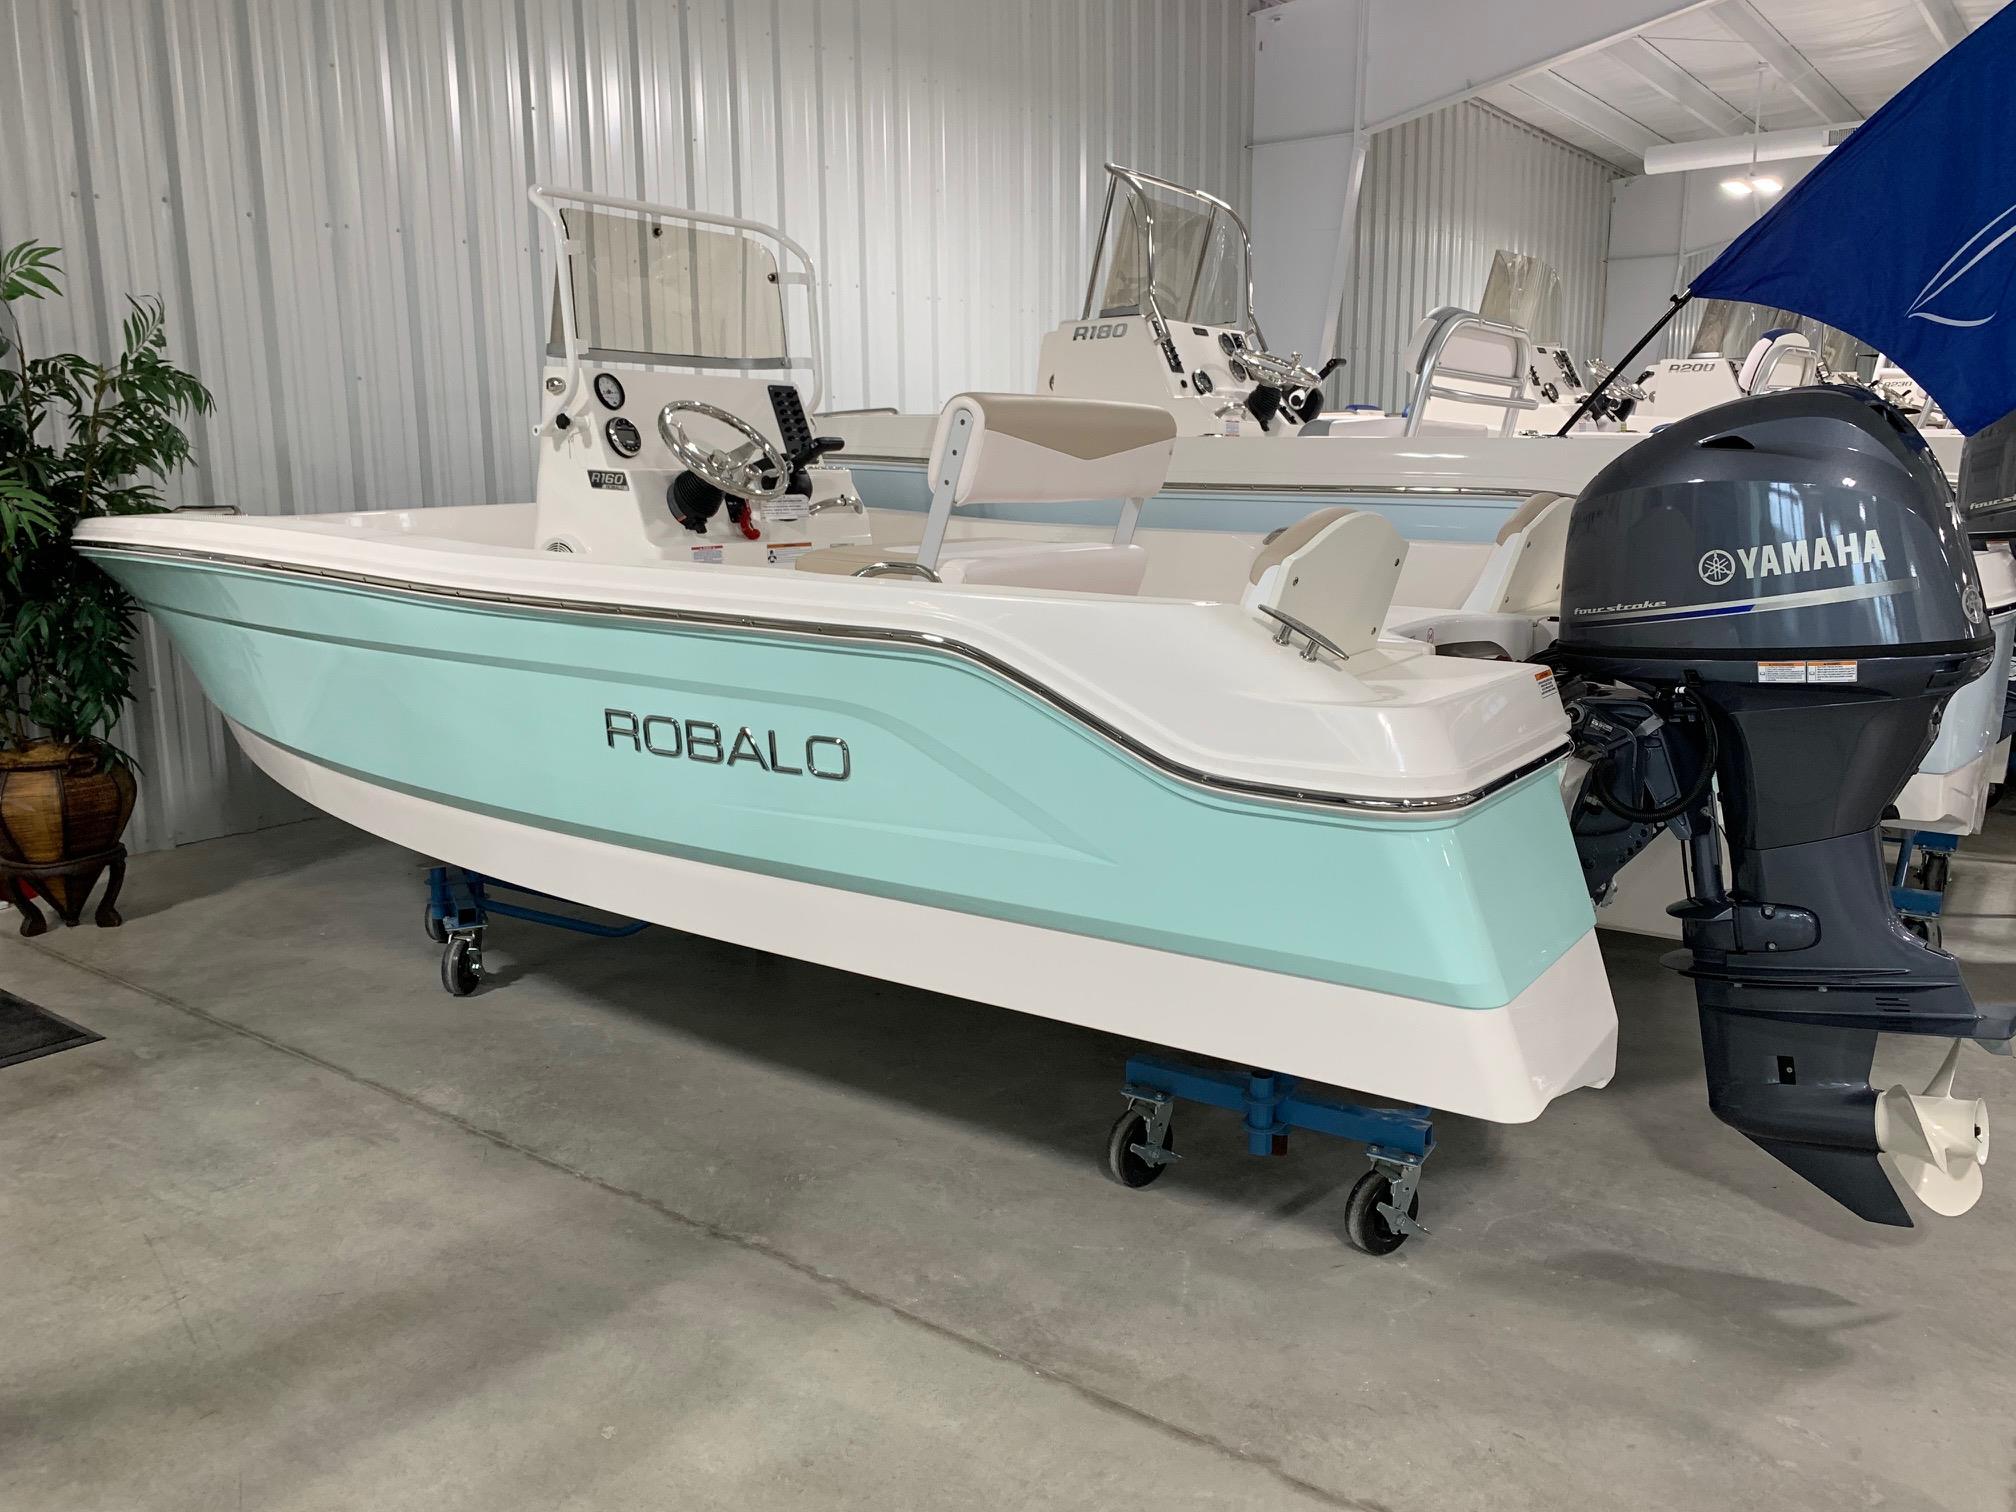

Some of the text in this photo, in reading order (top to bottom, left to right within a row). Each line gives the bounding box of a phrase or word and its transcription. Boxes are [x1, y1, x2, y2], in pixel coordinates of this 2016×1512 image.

[1073, 323, 1128, 341] R180
[1669, 363, 1715, 373] R200
[591, 472, 624, 485] R160
[1736, 529, 1886, 579] YAMAHA
[1574, 600, 1667, 615] fourstroke
[604, 708, 851, 782] ROBALO
